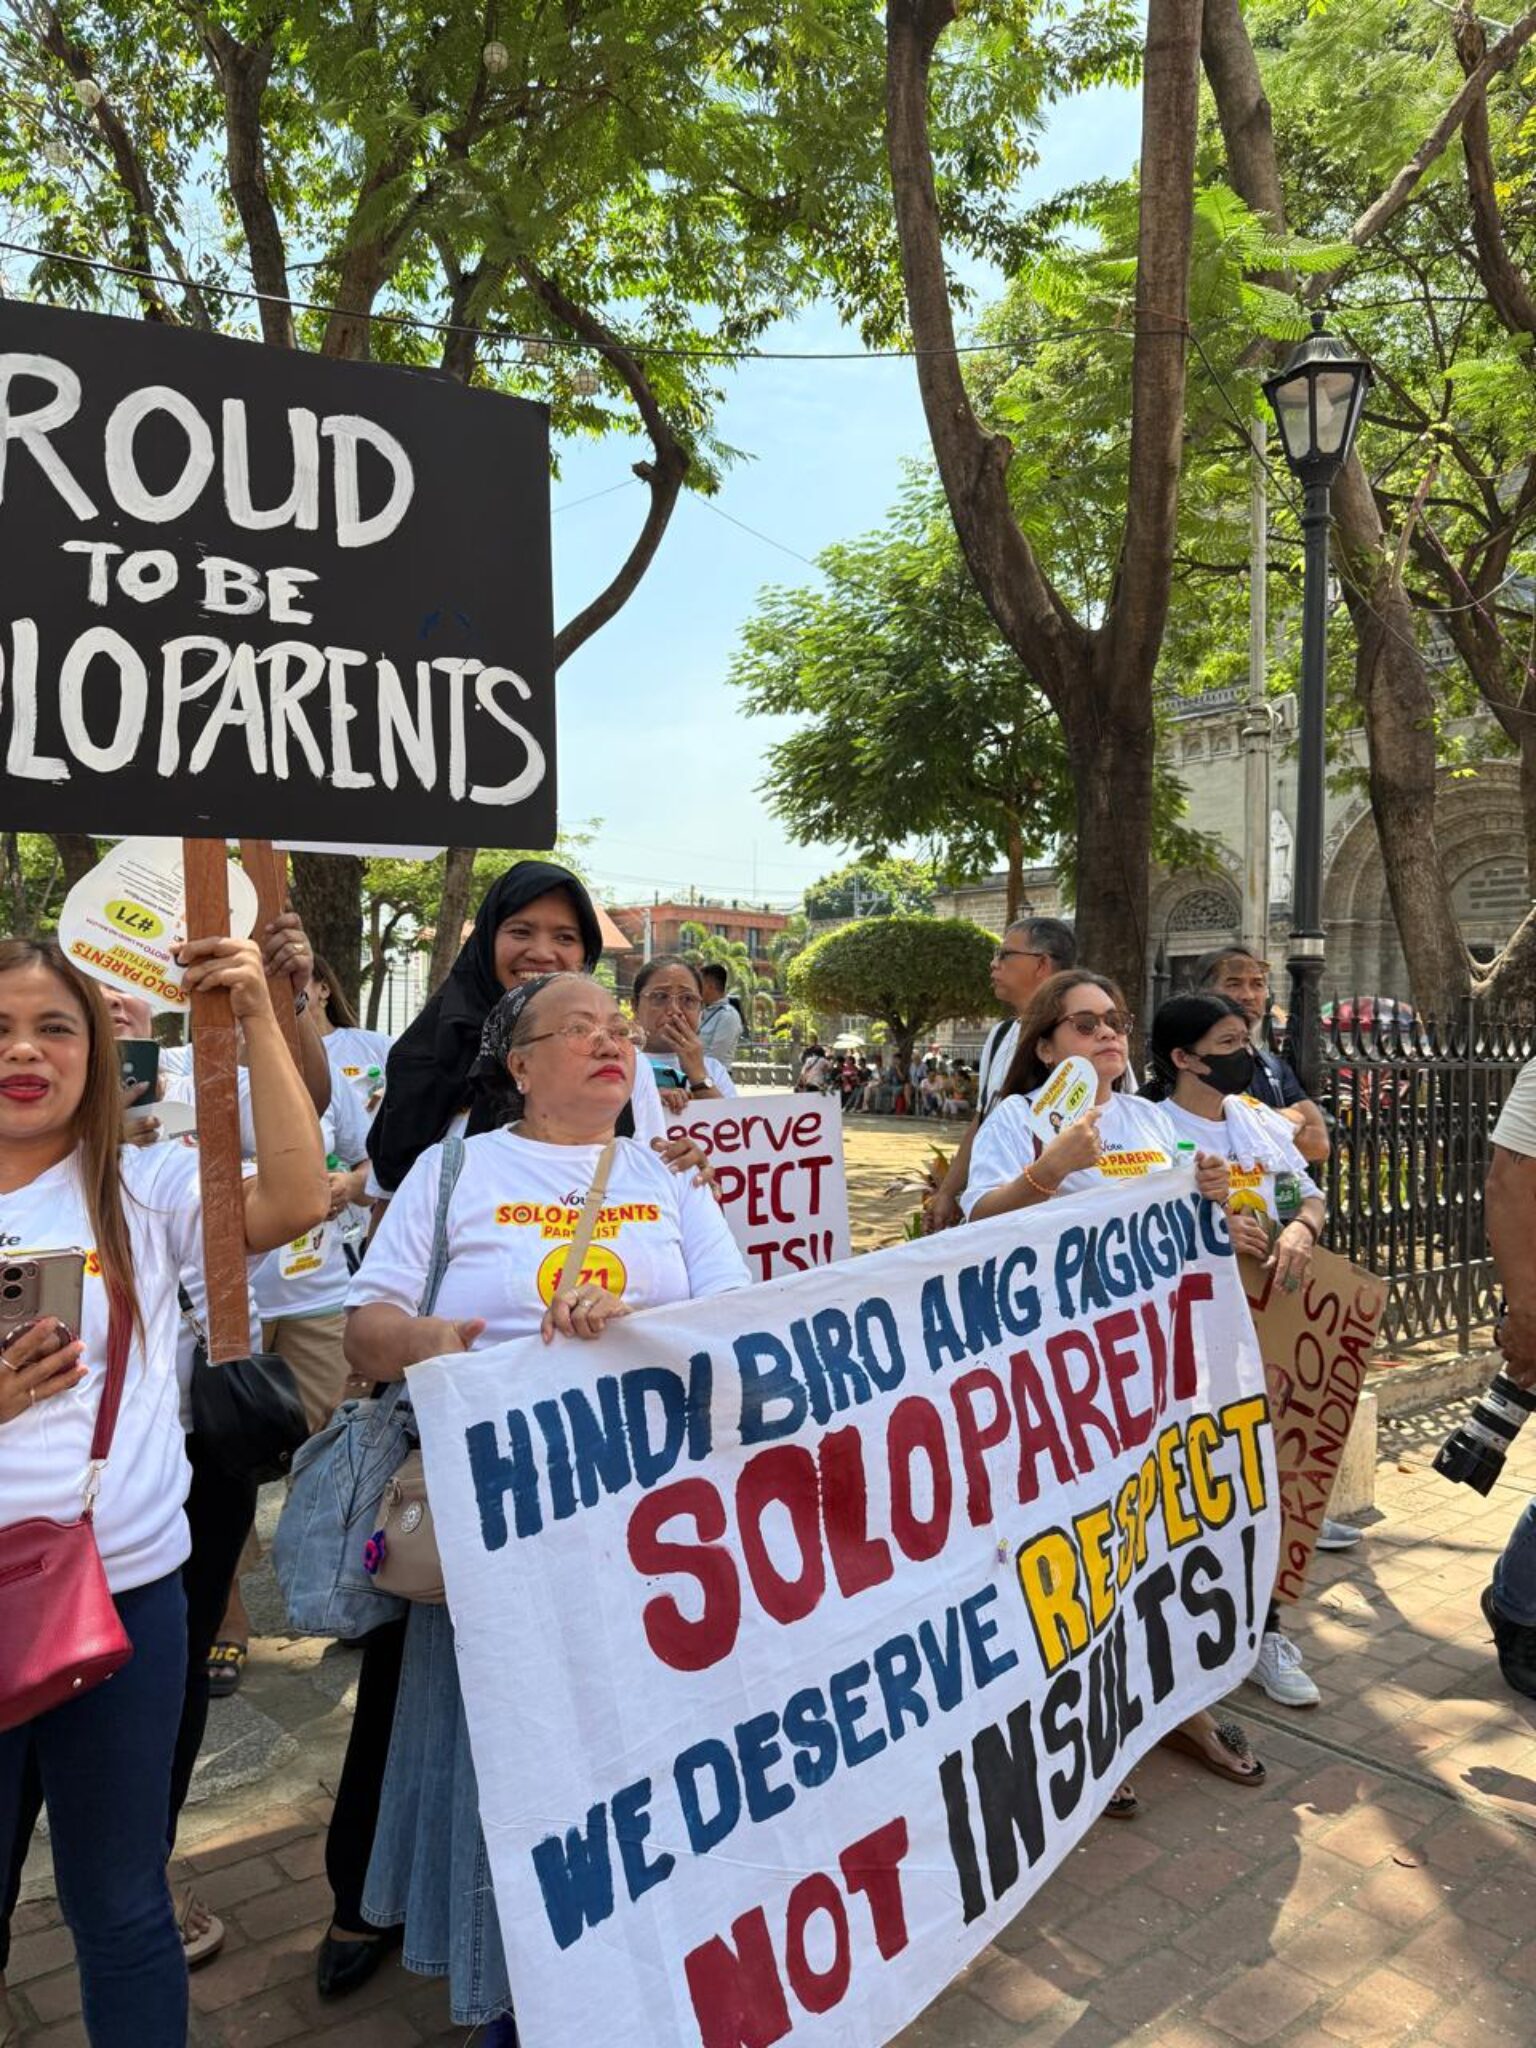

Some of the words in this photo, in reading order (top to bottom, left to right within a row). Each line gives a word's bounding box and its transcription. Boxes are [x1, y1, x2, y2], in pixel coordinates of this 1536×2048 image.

[61, 541, 180, 605] TO
[197, 556, 320, 625] BE
[115, 906, 154, 933] #71
[74, 941, 143, 982] PARENTS
[1069, 1087, 1084, 1106] #71
[498, 1205, 562, 1225] SOLO
[566, 1204, 660, 1225] PRENTS
[712, 1154, 833, 1226] PECT
[465, 1351, 713, 1551] HINDI
[733, 1297, 906, 1446] BIRO
[921, 1246, 1041, 1373] ANG
[1276, 1540, 1312, 1599] na
[531, 1777, 676, 1950] WE
[673, 1583, 1019, 1856] DESERVE
[1015, 1393, 1271, 1680] RESPECT
[683, 1815, 909, 2048] NOT
[938, 1525, 1256, 1927] INSULTS!
